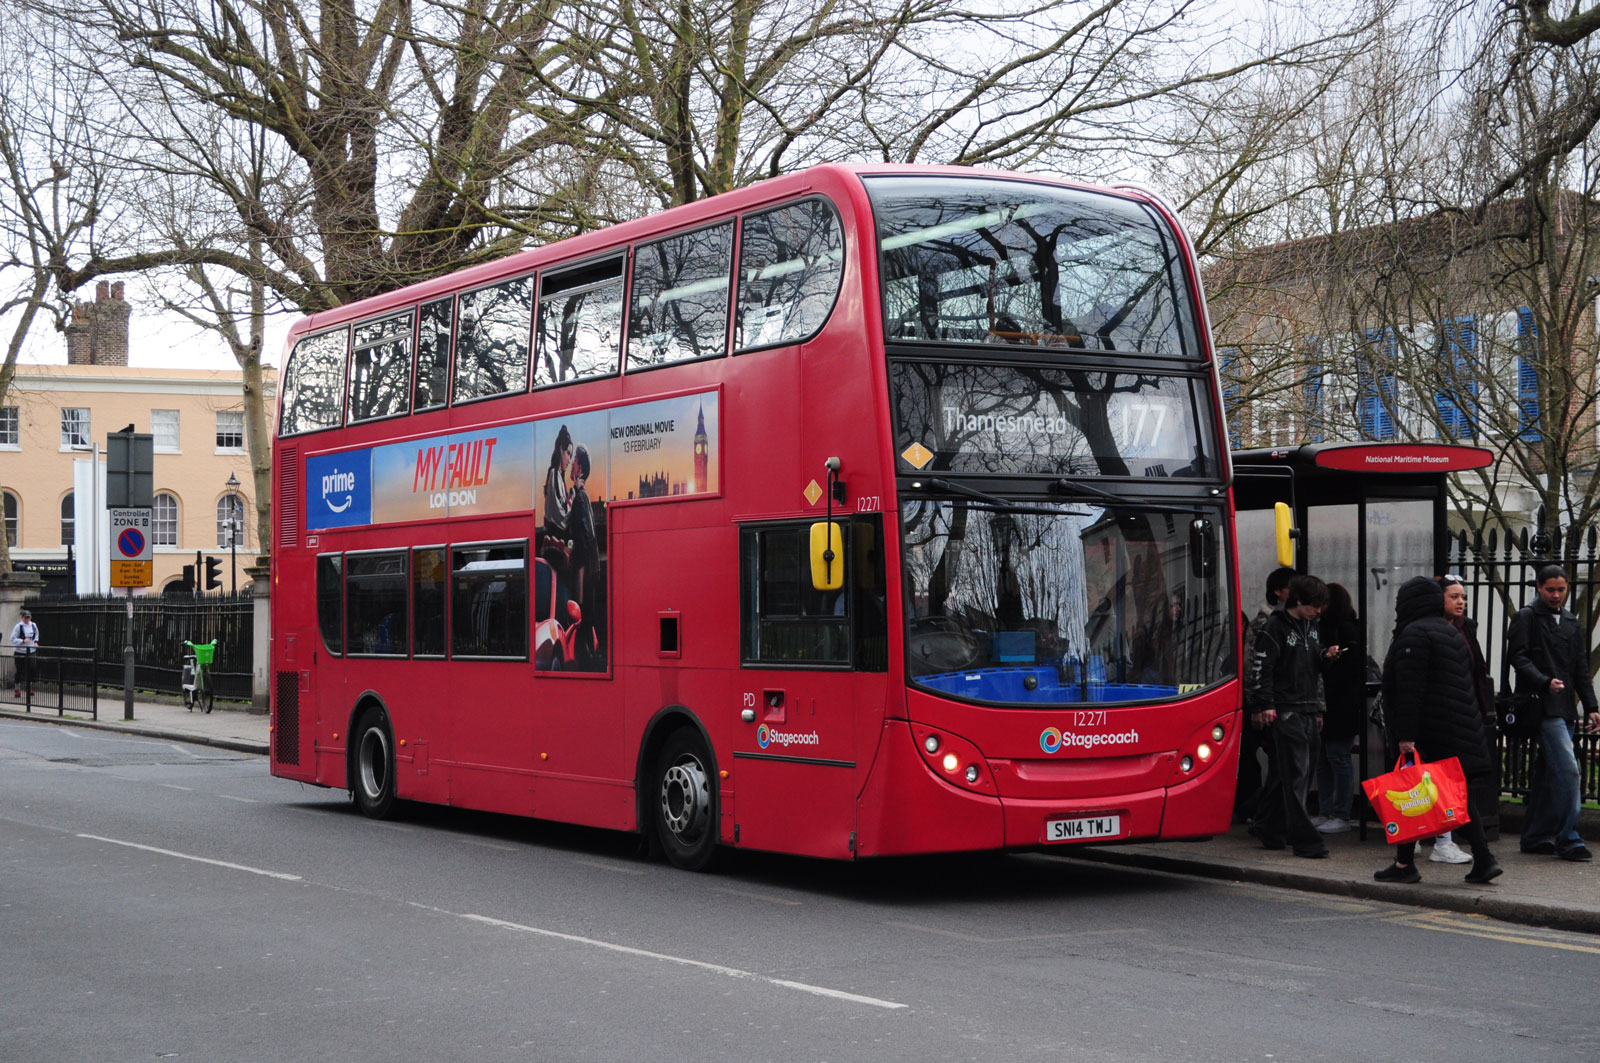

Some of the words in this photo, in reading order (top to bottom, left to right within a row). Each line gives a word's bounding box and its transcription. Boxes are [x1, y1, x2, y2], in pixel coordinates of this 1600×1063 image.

[610, 426, 625, 440] NEW
[625, 422, 654, 437] ORIGINAL
[654, 419, 675, 434] MOVIE
[943, 406, 1066, 434] Thamesmead
[1122, 404, 1167, 447] 177
[623, 441, 630, 453] 13
[630, 437, 662, 452] FEBRUARY
[412, 445, 444, 493] MY
[441, 437, 497, 490] FAULT
[1365, 455, 1393, 463] National
[1393, 455, 1422, 463] Maritime
[1422, 455, 1450, 463] Museum
[322, 468, 355, 499] prime
[429, 489, 477, 509] LONDON
[857, 495, 881, 512] 12271
[112, 509, 150, 517] Controlled
[113, 518, 140, 526] ZONE
[743, 692, 756, 707] PD
[1073, 711, 1107, 727] 12271
[770, 729, 819, 747] Stagecoach
[1062, 728, 1139, 749] Stagecoach
[1055, 820, 1083, 838] SN14
[1087, 817, 1112, 834] TWJ
